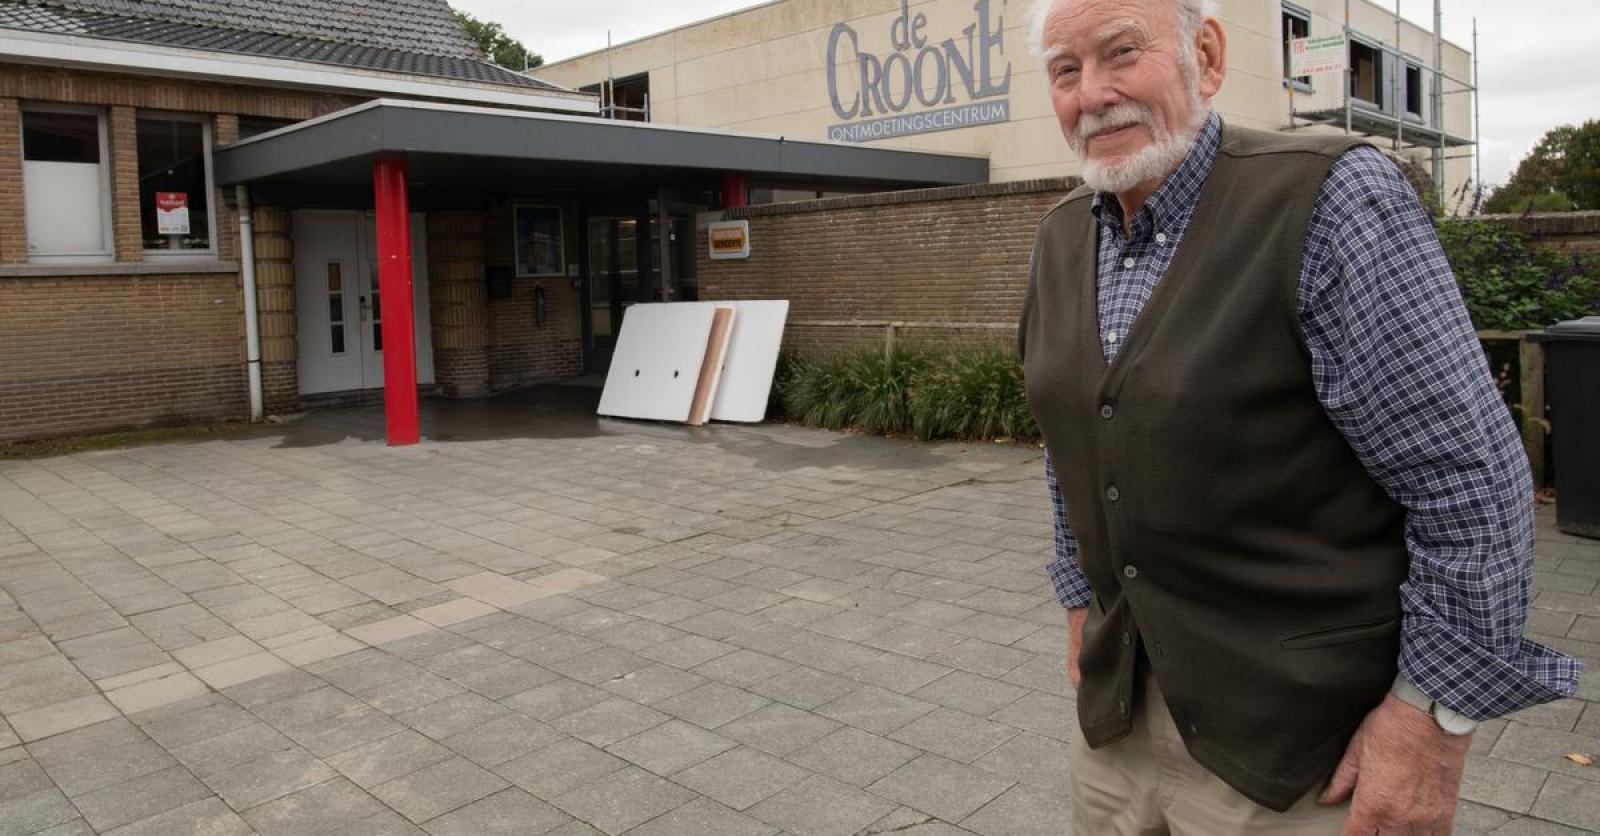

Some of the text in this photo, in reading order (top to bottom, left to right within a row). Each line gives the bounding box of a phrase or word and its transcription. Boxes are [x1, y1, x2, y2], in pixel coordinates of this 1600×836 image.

[891, 0, 927, 51] de
[827, 0, 1011, 120] CROONE
[831, 103, 1006, 142] ONTMOETINGSCENTRUM
